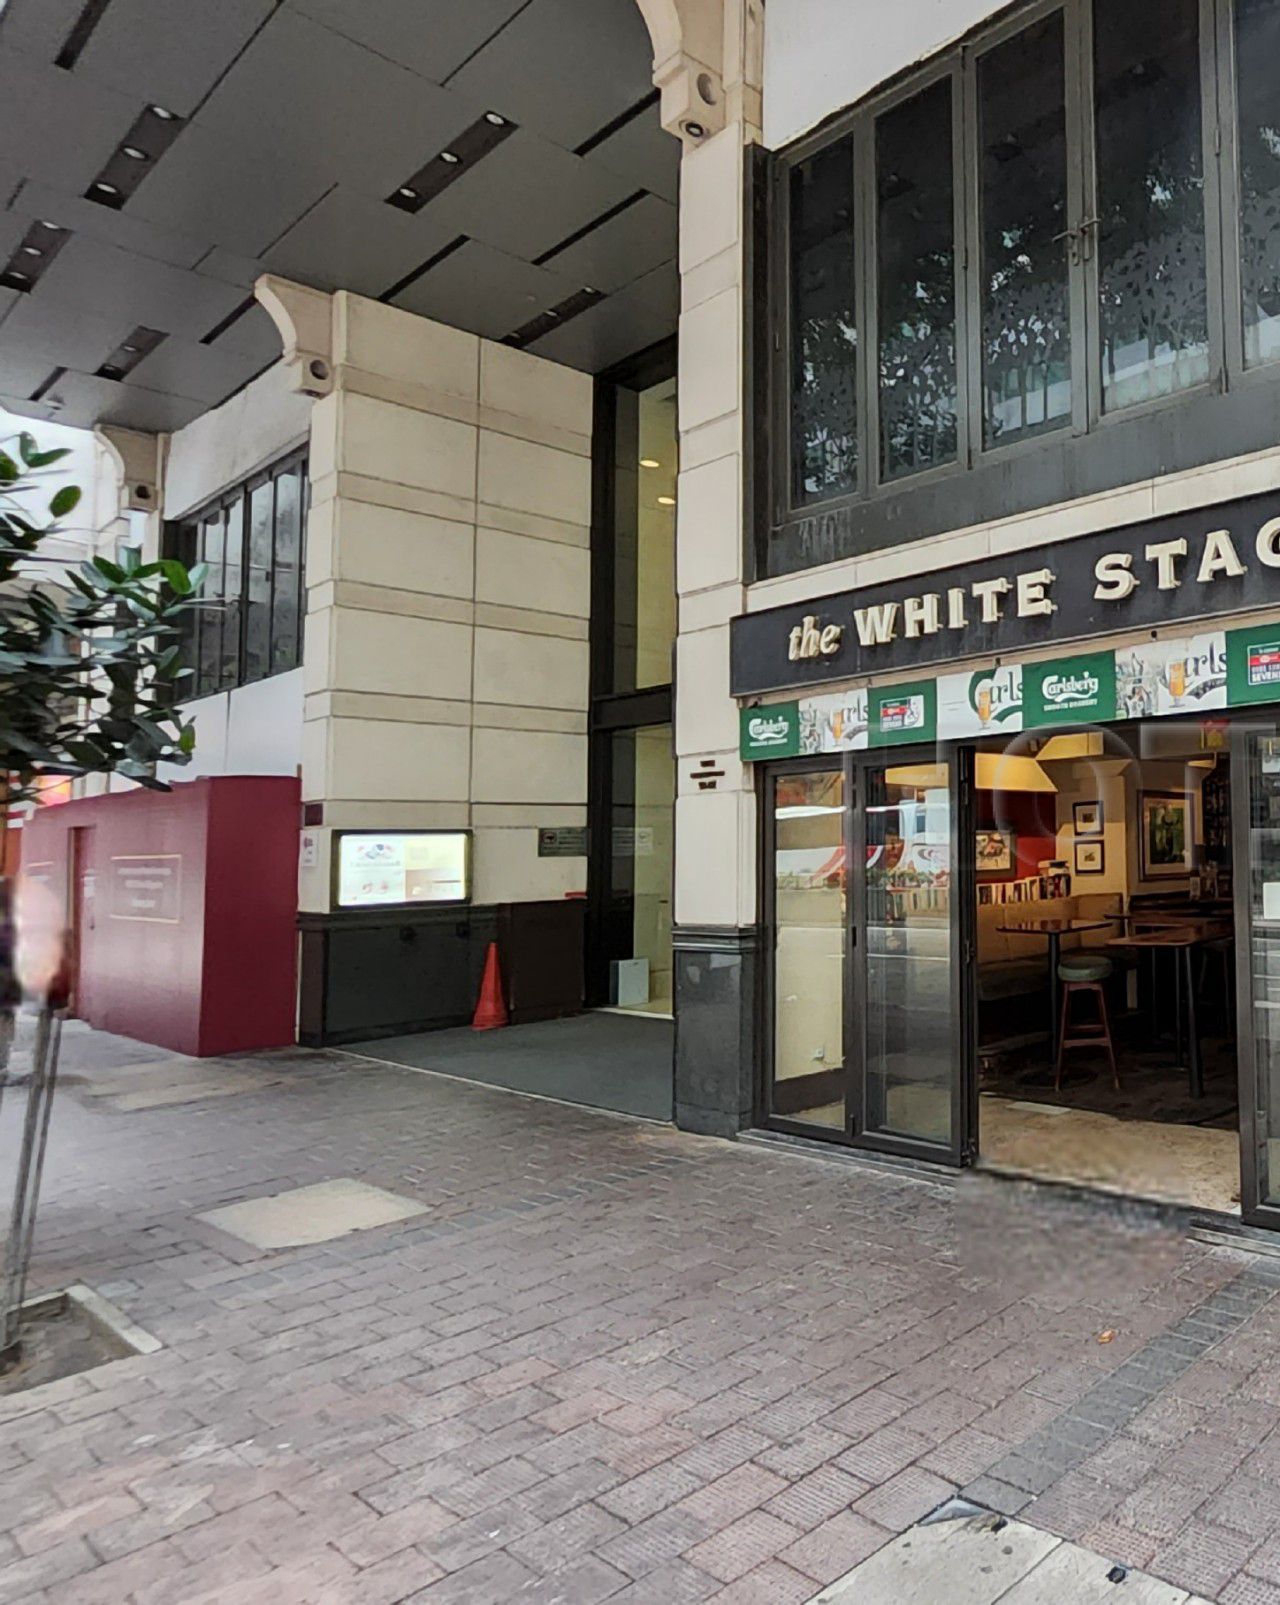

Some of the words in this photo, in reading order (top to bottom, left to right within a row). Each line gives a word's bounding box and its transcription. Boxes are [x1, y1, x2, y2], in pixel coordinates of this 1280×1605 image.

[788, 614, 843, 661] the
[854, 568, 1057, 646] WHITE
[1042, 671, 1099, 702] Carlsberg
